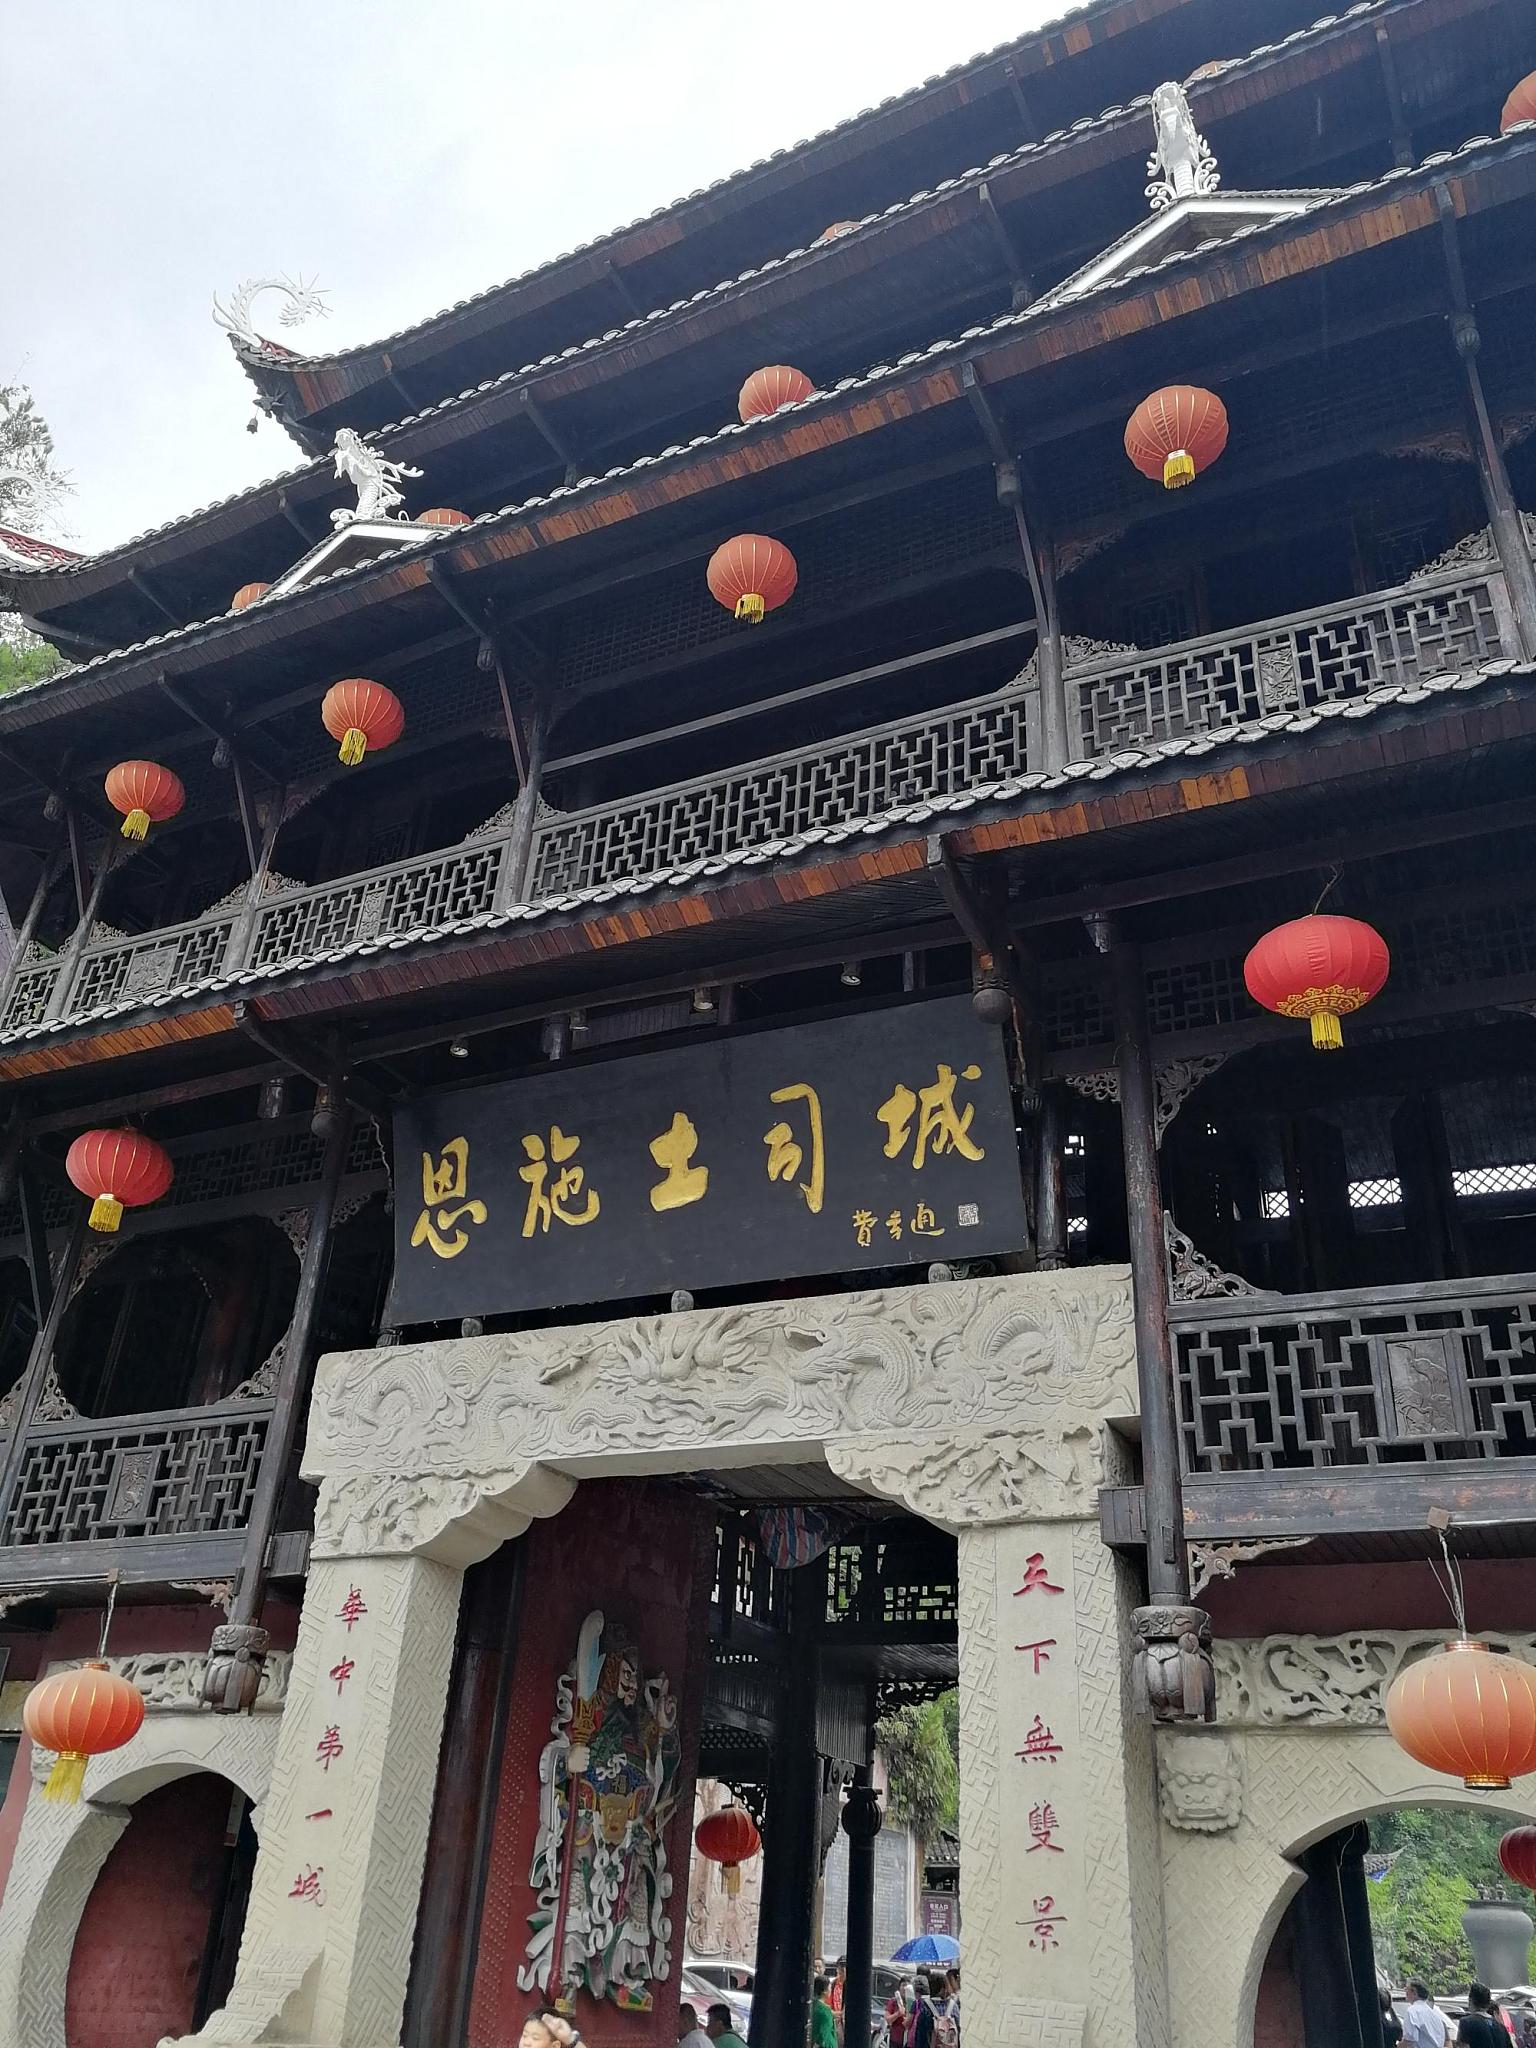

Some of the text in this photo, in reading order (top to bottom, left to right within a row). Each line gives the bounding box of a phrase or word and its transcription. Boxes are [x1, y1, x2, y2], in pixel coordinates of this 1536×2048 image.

[411, 1064, 985, 1260] 恩施土司城
[1012, 1552, 1068, 1953] 天下無雙景
